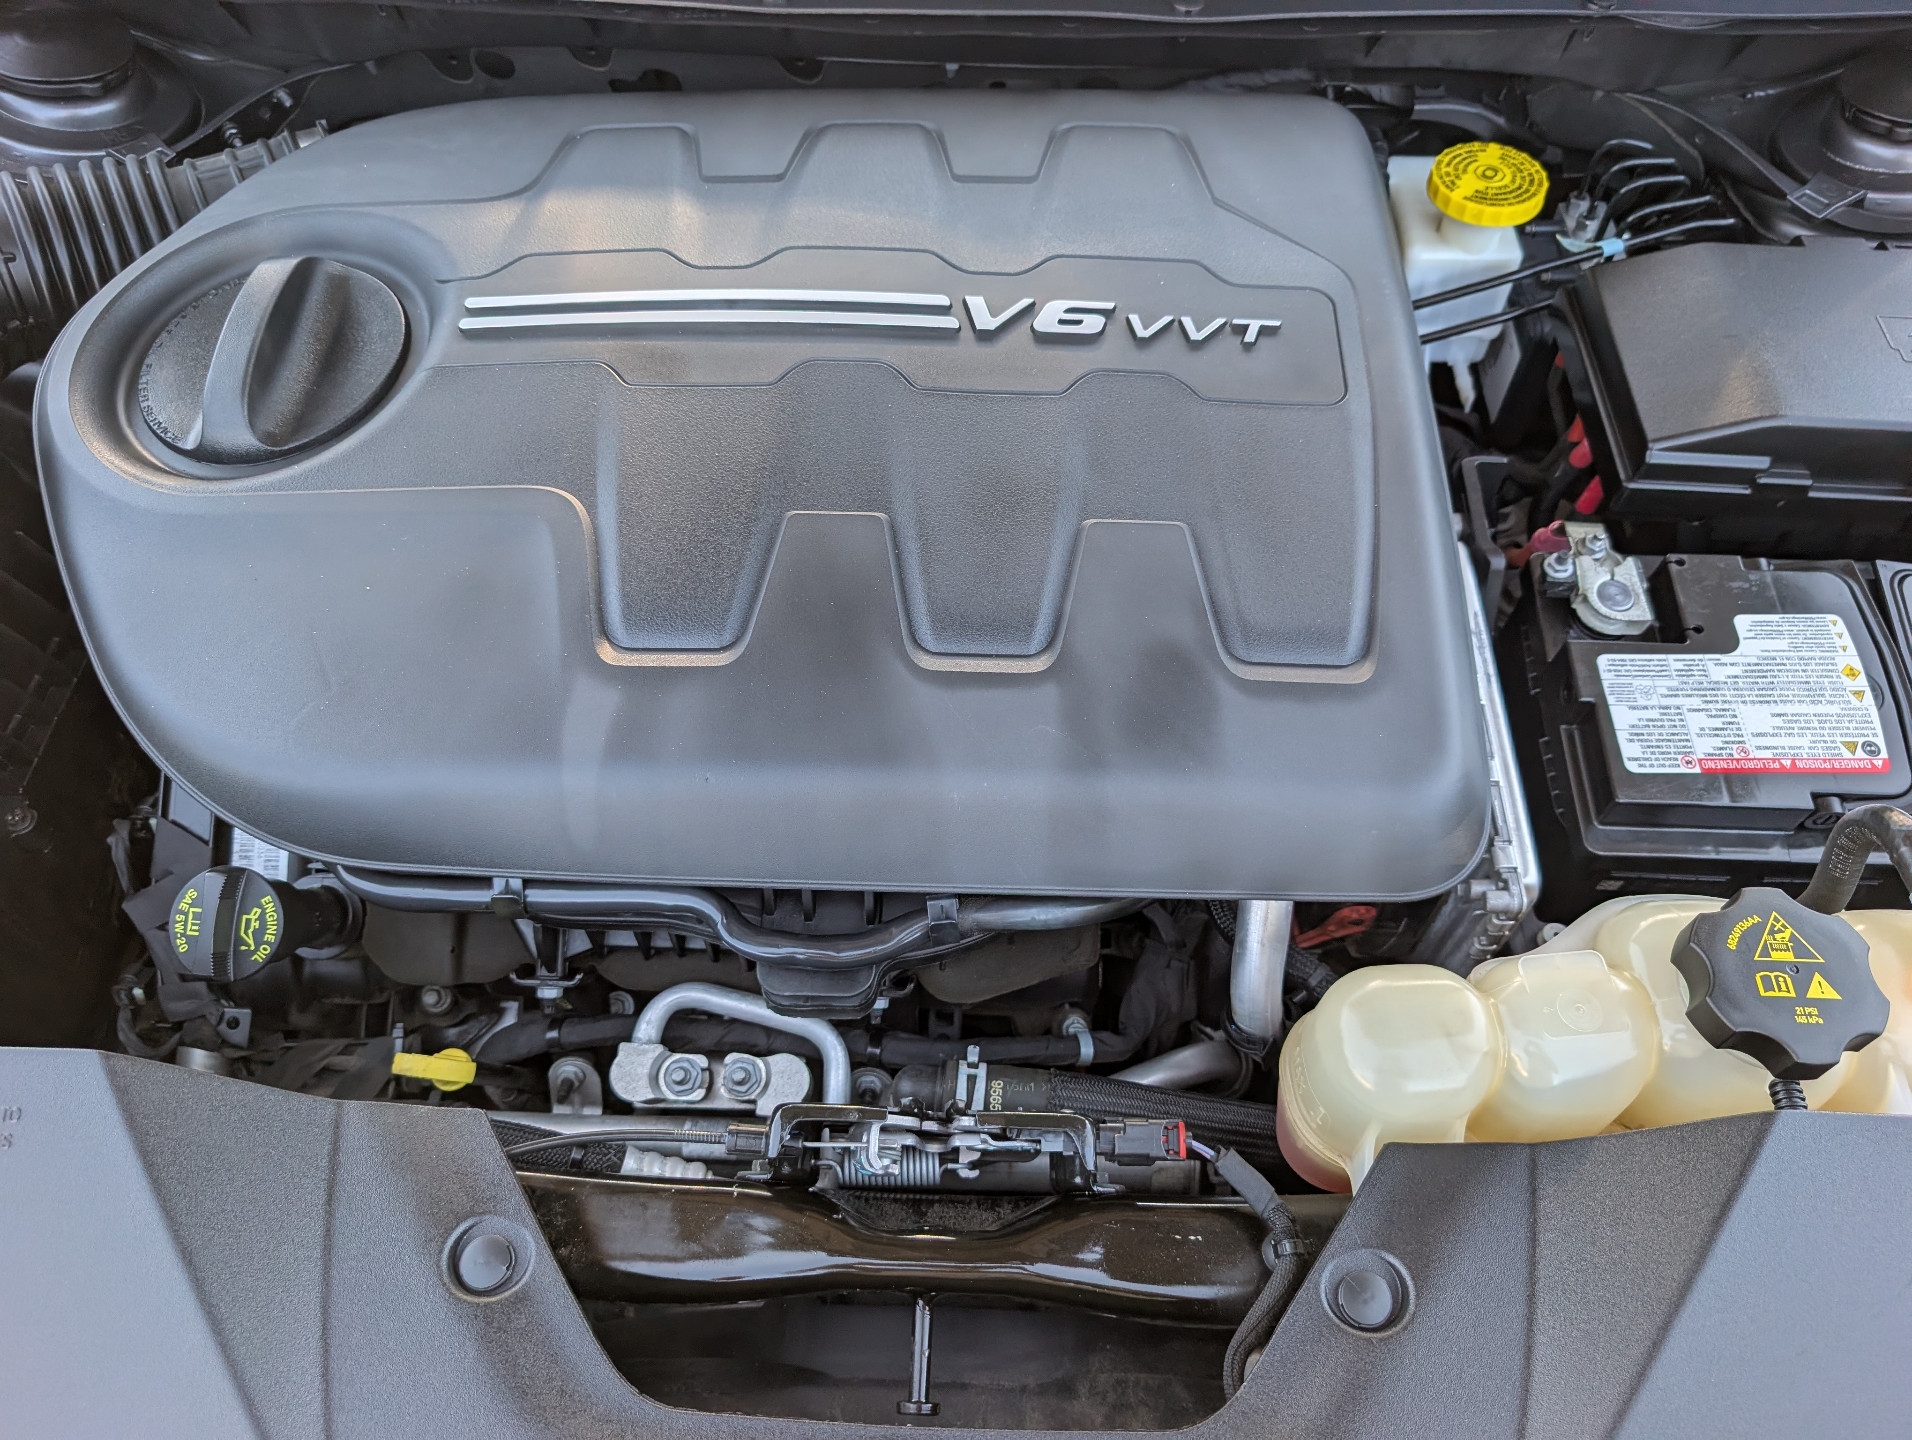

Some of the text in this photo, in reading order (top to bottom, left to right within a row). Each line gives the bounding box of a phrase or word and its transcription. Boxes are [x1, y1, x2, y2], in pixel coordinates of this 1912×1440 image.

[964, 294, 1283, 346] V6 VVT
[137, 362, 153, 403] FILTER
[1701, 759, 1871, 769] DANGER/POISON PELIGRO/VENENO
[174, 888, 198, 953] SAE 5W-20
[261, 895, 278, 943] ENGINE
[1726, 914, 1763, 950] 68249136AA
[251, 944, 271, 963] OIL
[1794, 1015, 1824, 1025] 145 kPa
[1795, 1006, 1819, 1016] 21 PSI
